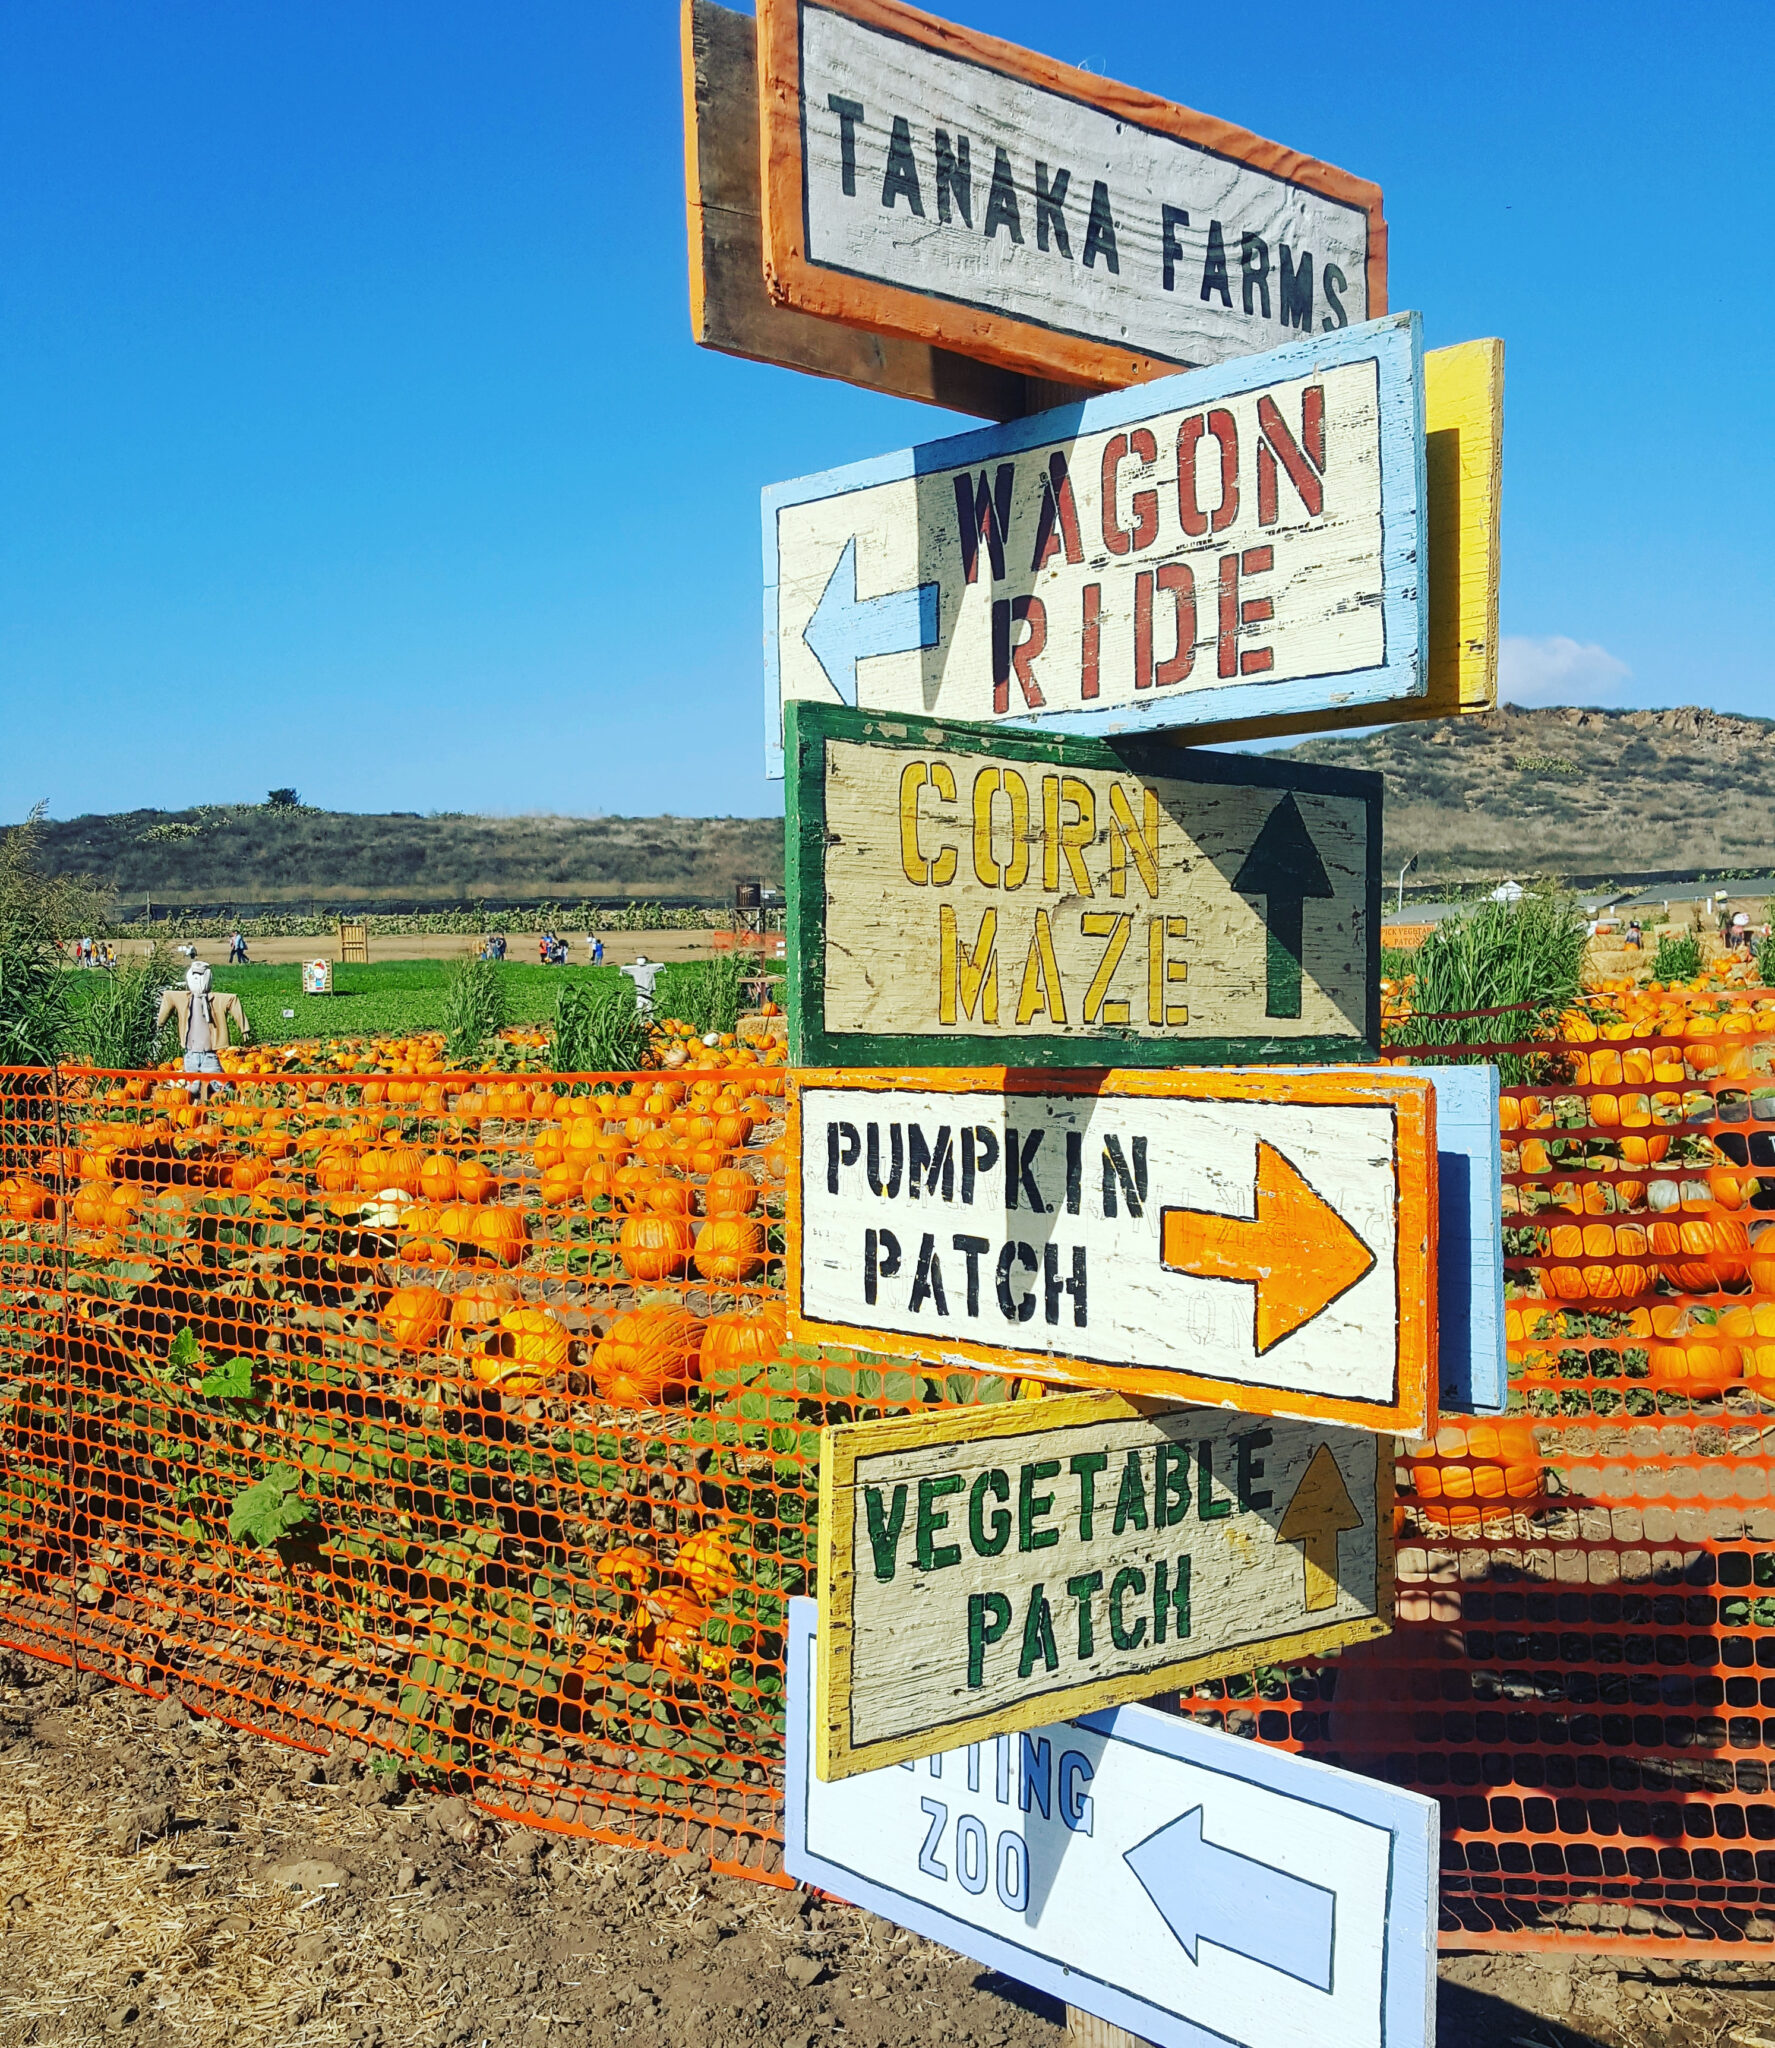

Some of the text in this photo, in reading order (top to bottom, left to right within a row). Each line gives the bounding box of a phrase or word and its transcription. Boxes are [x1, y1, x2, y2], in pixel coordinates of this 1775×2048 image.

[828, 93, 1349, 333] TANAKA FARMS
[952, 385, 1328, 585] WAGON
[991, 544, 1275, 714] RIDE
[899, 760, 1160, 899] CORN
[938, 903, 1189, 1026] MAZE
[826, 1121, 1148, 1218] PUMPKIN
[864, 1228, 1088, 1328] PATCH
[863, 1427, 1275, 1583] VEGETABLE
[967, 1554, 1191, 1690] PATCH
[918, 1795, 1030, 1912] ZOO
